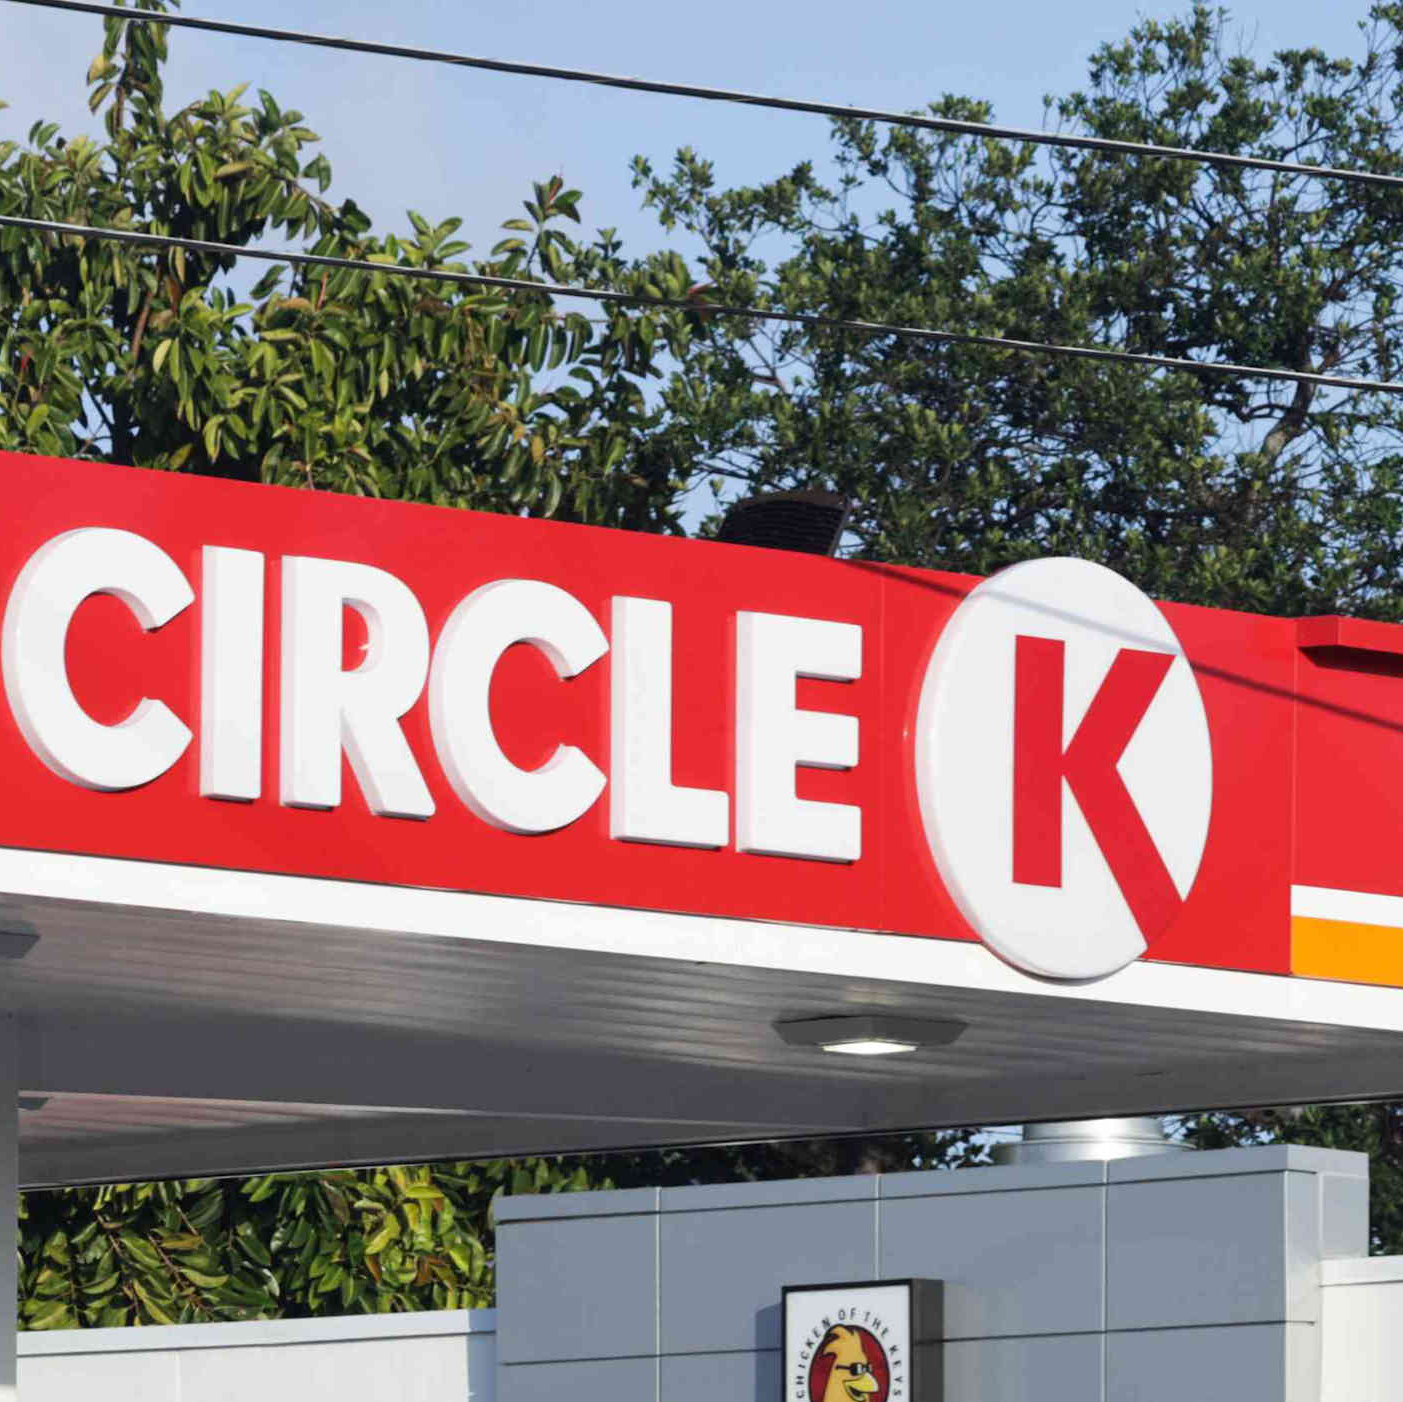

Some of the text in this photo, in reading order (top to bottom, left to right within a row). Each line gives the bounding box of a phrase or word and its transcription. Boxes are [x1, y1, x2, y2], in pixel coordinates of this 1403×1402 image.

[1, 526, 864, 864] CIRCLE
[796, 1307, 904, 1399] CHICKEN OF THE KEYS
